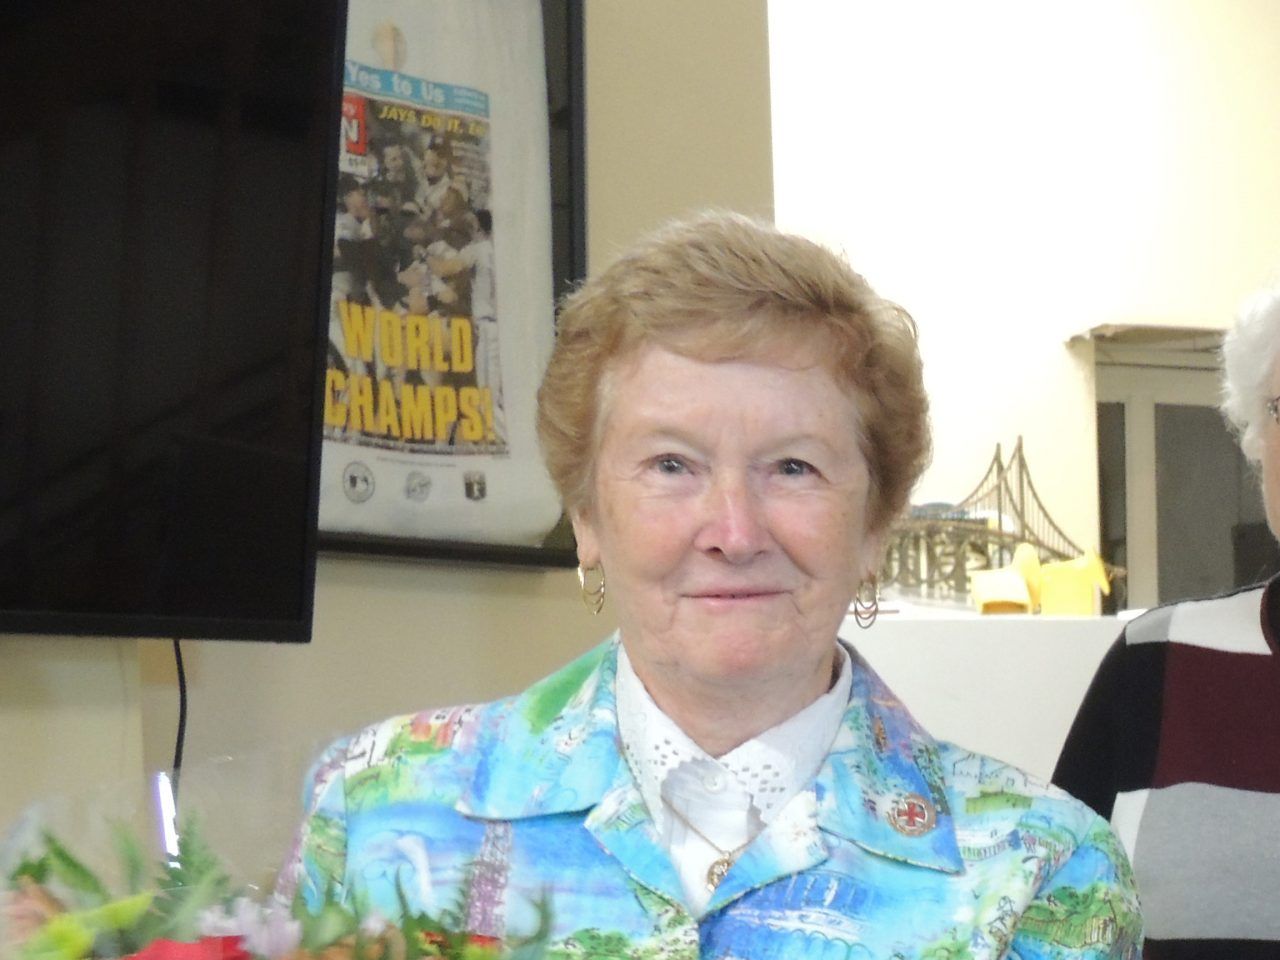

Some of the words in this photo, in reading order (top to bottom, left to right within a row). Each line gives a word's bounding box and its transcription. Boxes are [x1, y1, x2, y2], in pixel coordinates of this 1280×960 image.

[346, 63, 381, 90] Yes
[393, 73, 412, 96] to
[339, 302, 473, 373] WORLD
[323, 367, 496, 441] CHAMPS!
